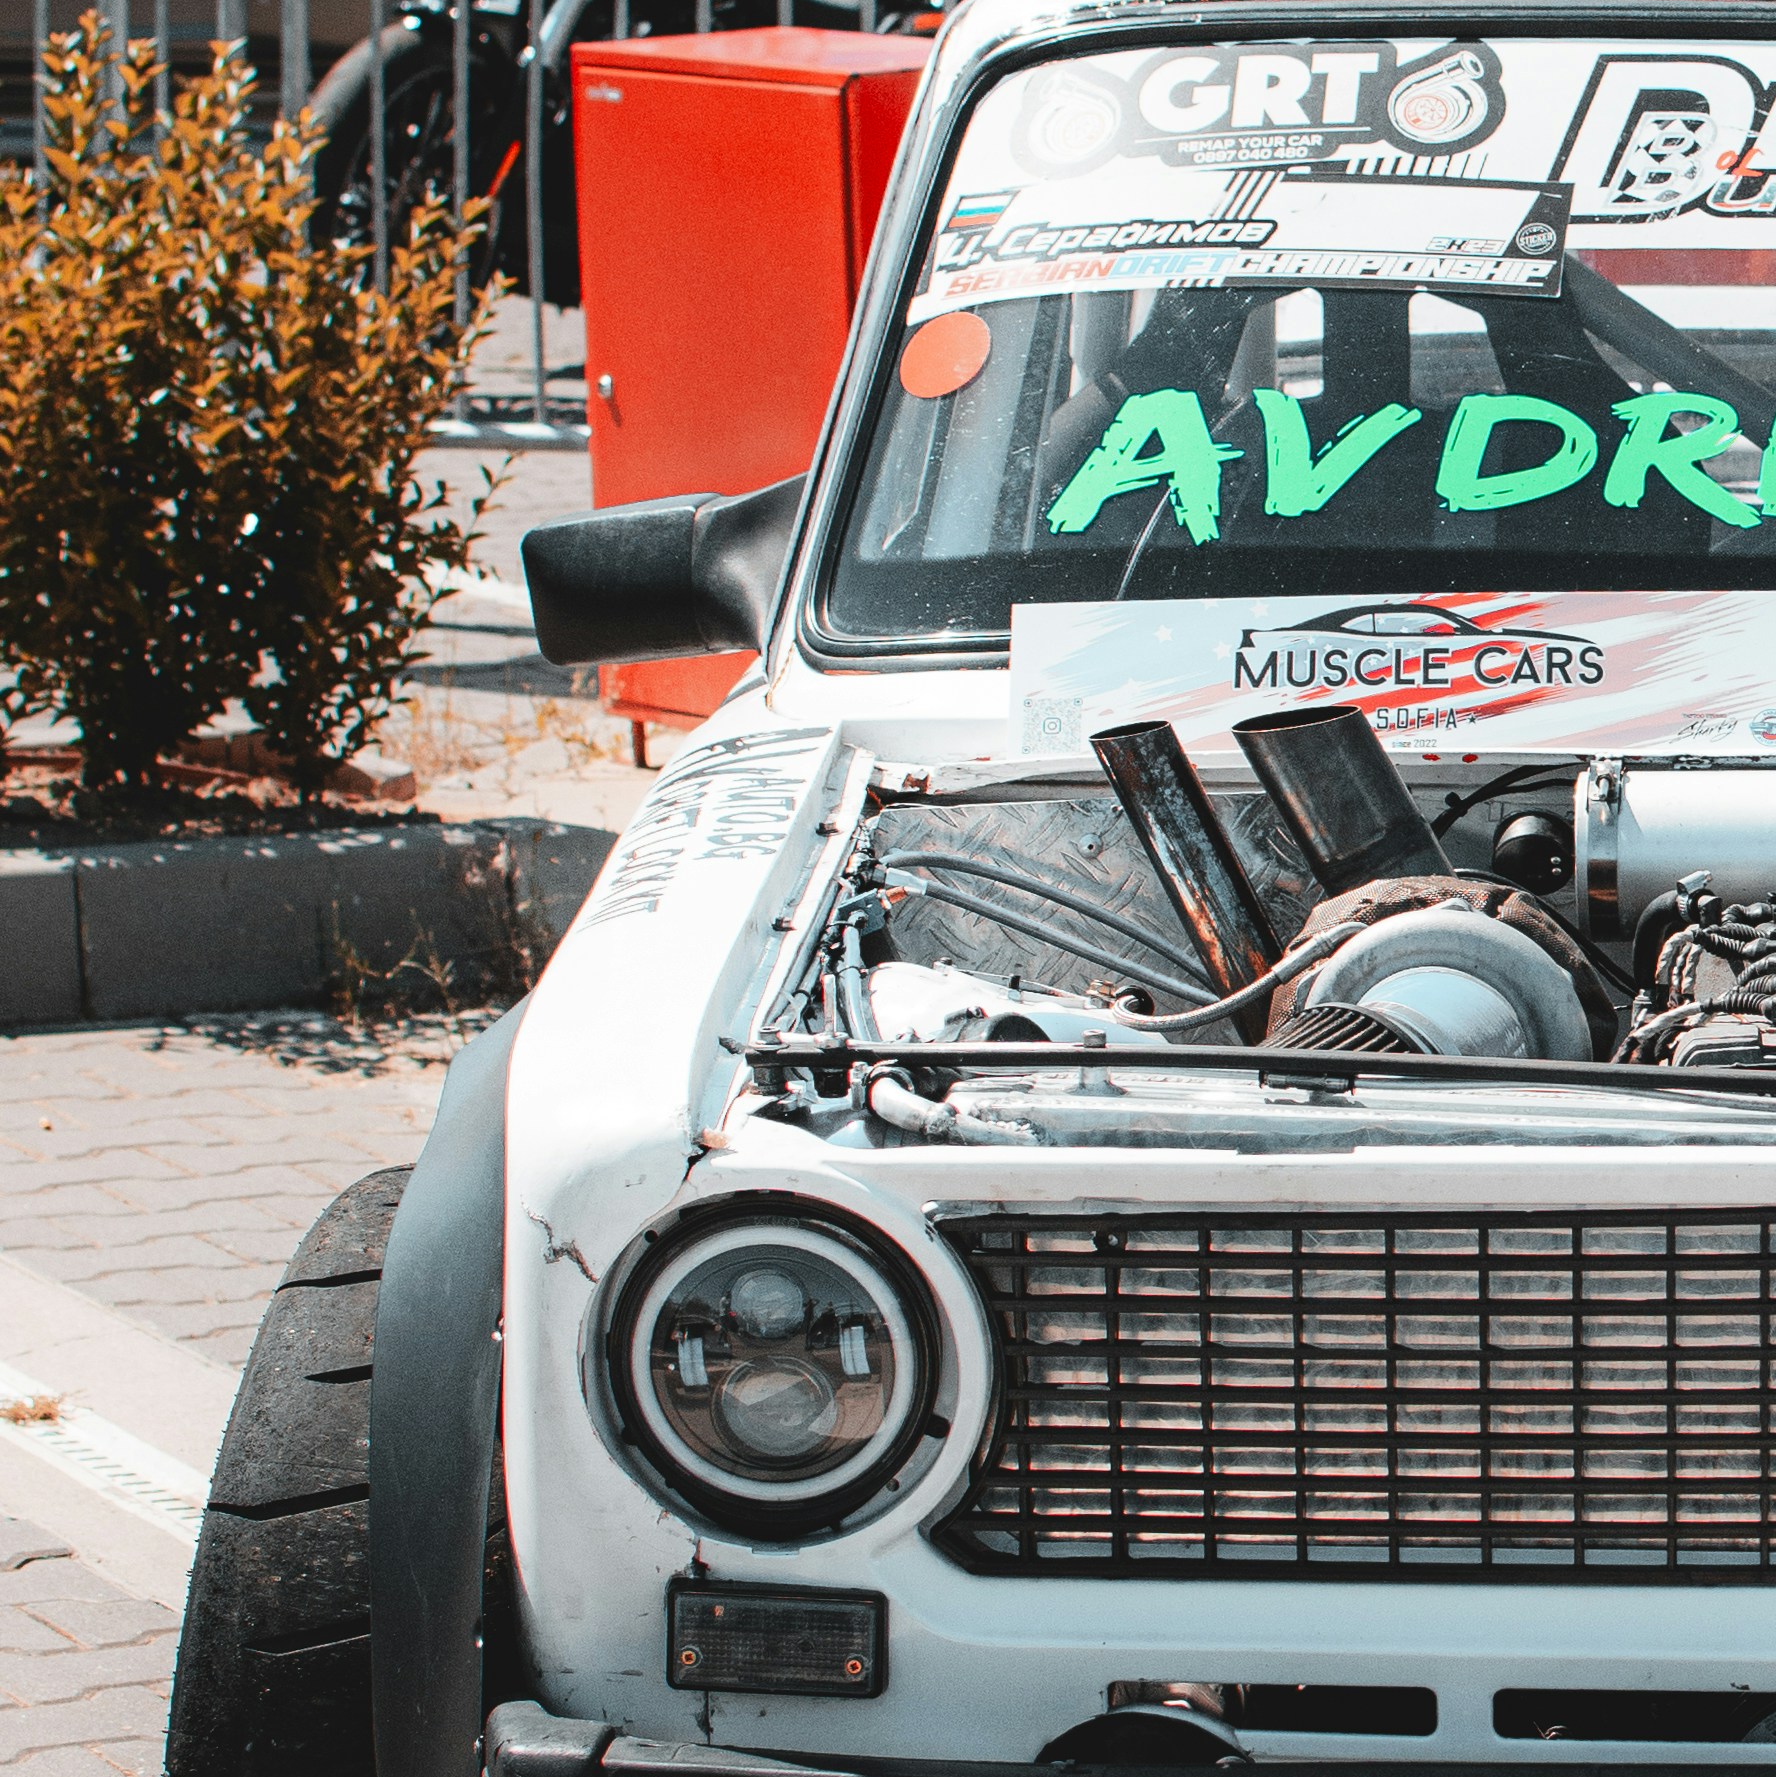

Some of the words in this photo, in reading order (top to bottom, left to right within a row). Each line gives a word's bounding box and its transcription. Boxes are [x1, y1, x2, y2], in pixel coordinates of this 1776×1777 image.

[1139, 51, 1379, 133] GRT
[1178, 138, 1236, 153] REMAP
[1238, 135, 1286, 149] YOUR
[1287, 134, 1323, 147] CAR
[1231, 645, 1449, 691] MUSCLE
[1473, 644, 1605, 687] CARS
[1376, 707, 1457, 730] SOFIA
[1413, 739, 1438, 748] 2022
